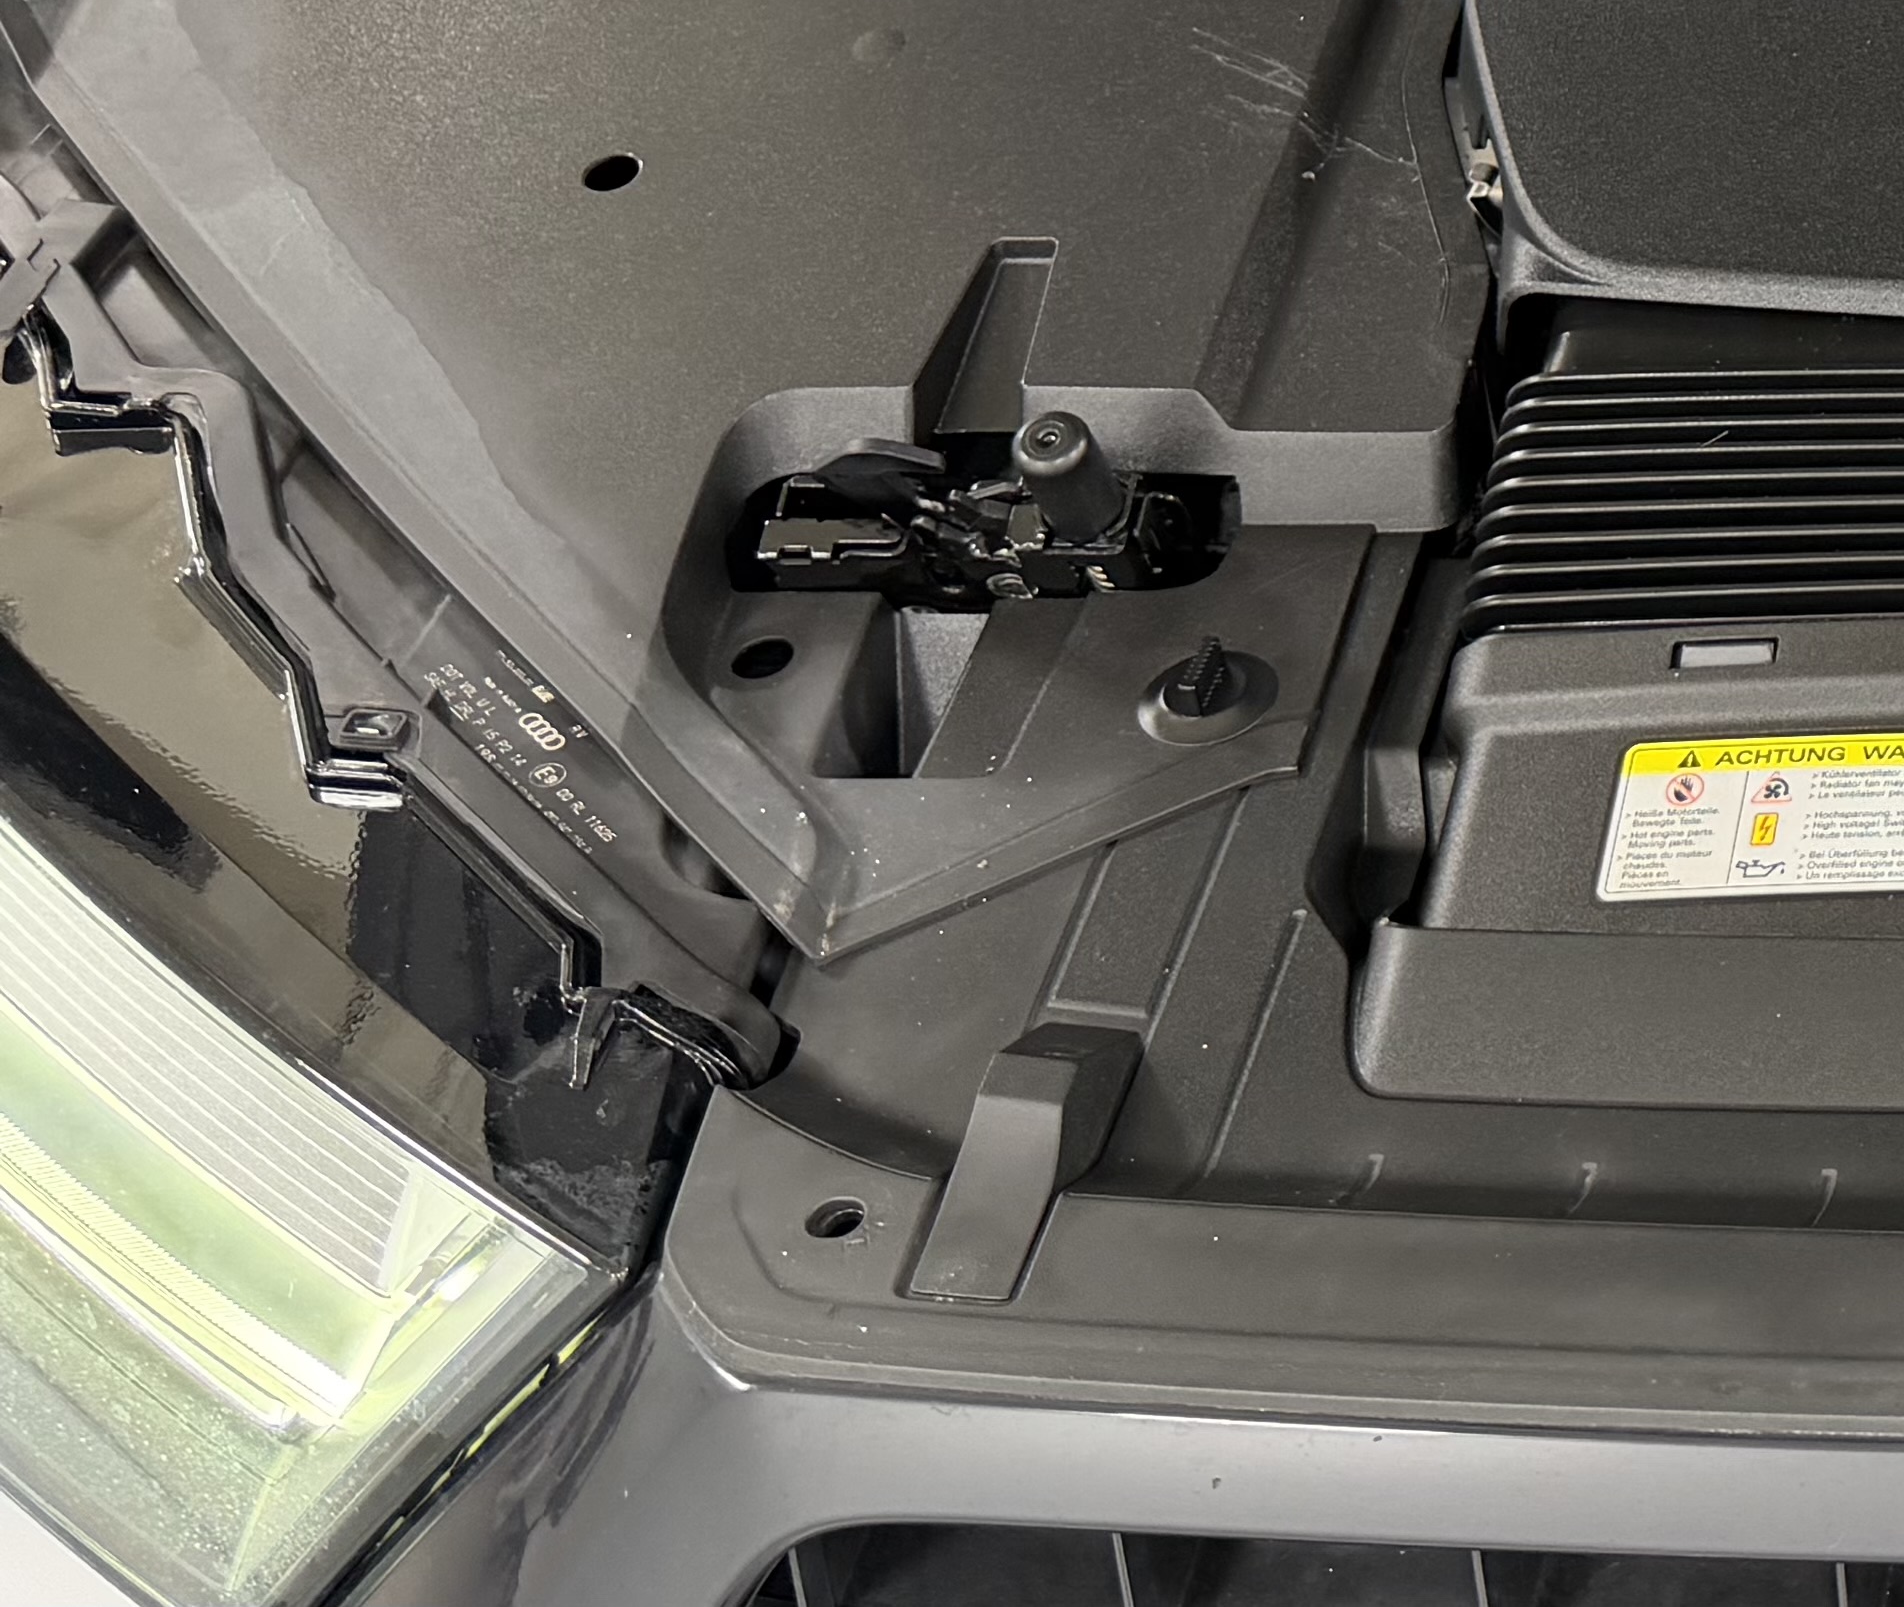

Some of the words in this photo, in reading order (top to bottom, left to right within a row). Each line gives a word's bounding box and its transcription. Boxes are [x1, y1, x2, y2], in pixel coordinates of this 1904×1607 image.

[423, 672, 446, 688] SAE
[1715, 746, 1846, 766] ACHTUNG
[533, 765, 557, 787] E9
[1819, 780, 1861, 788] Radiator
[1865, 779, 1881, 787] fan
[1882, 780, 1904, 789] may
[1818, 791, 1830, 799] Le
[1832, 789, 1885, 799] ventilateur
[584, 815, 616, 842] 11625
[1632, 819, 1676, 828] Bewegte
[1813, 820, 1837, 830] High
[1630, 831, 1648, 839] Hot
[1650, 830, 1685, 839] engine
[1687, 829, 1714, 837] parts.
[1628, 840, 1666, 849] Moving
[1668, 839, 1696, 848] parts.
[1660, 851, 1673, 859] du
[1676, 850, 1713, 858] moteur
[1809, 851, 1825, 859] Bei
[1806, 860, 1857, 869] Overfilled
[1859, 860, 1894, 869] engine
[1806, 871, 1820, 880] Un
[1823, 870, 1885, 880] remplissage
